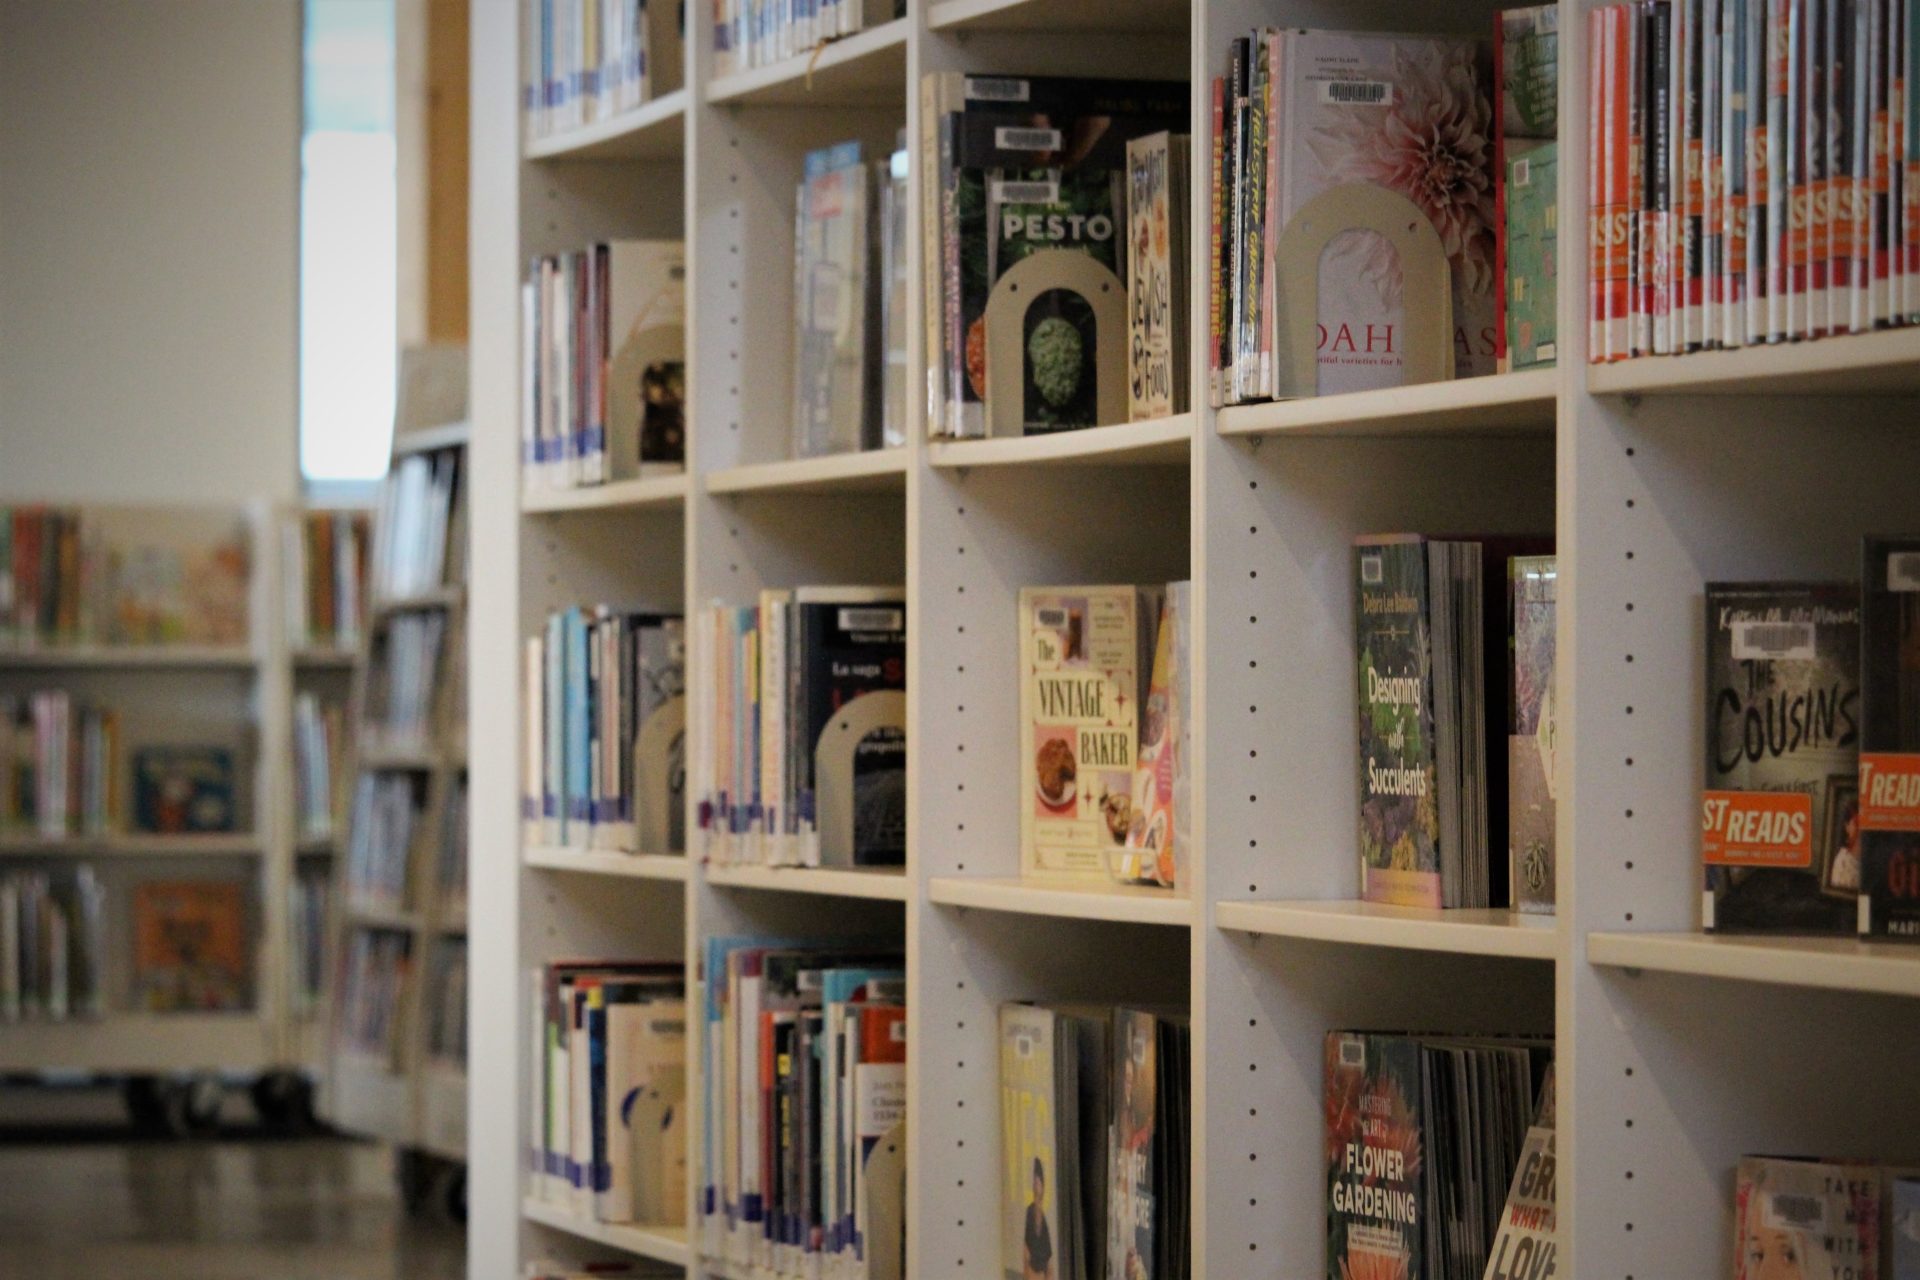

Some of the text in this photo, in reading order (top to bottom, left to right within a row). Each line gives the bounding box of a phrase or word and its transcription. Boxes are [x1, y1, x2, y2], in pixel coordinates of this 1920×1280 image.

[1002, 214, 1113, 241] PESTO
[1210, 136, 1222, 336] FEARLESS GARDENING
[1248, 107, 1262, 328] HELLSTRIP GARDENI
[1341, 357, 1375, 366] varieties
[1379, 357, 1393, 366] for
[1038, 639, 1055, 662] The
[1368, 667, 1421, 716] Designing
[1740, 659, 1776, 695] THE
[1038, 679, 1105, 718] VINTAGE
[1714, 683, 1860, 775] COUSINS
[1080, 731, 1130, 766] BAKER
[1368, 757, 1427, 797] Succulents
[1869, 773, 1920, 807] READ
[1726, 810, 1807, 845] READS
[1358, 1095, 1392, 1116] MASTERING
[1346, 1143, 1404, 1182] FLOWER
[1519, 1151, 1556, 1203] GR
[1333, 1181, 1416, 1225] GARDENING
[1509, 1202, 1550, 1232] WHAT
